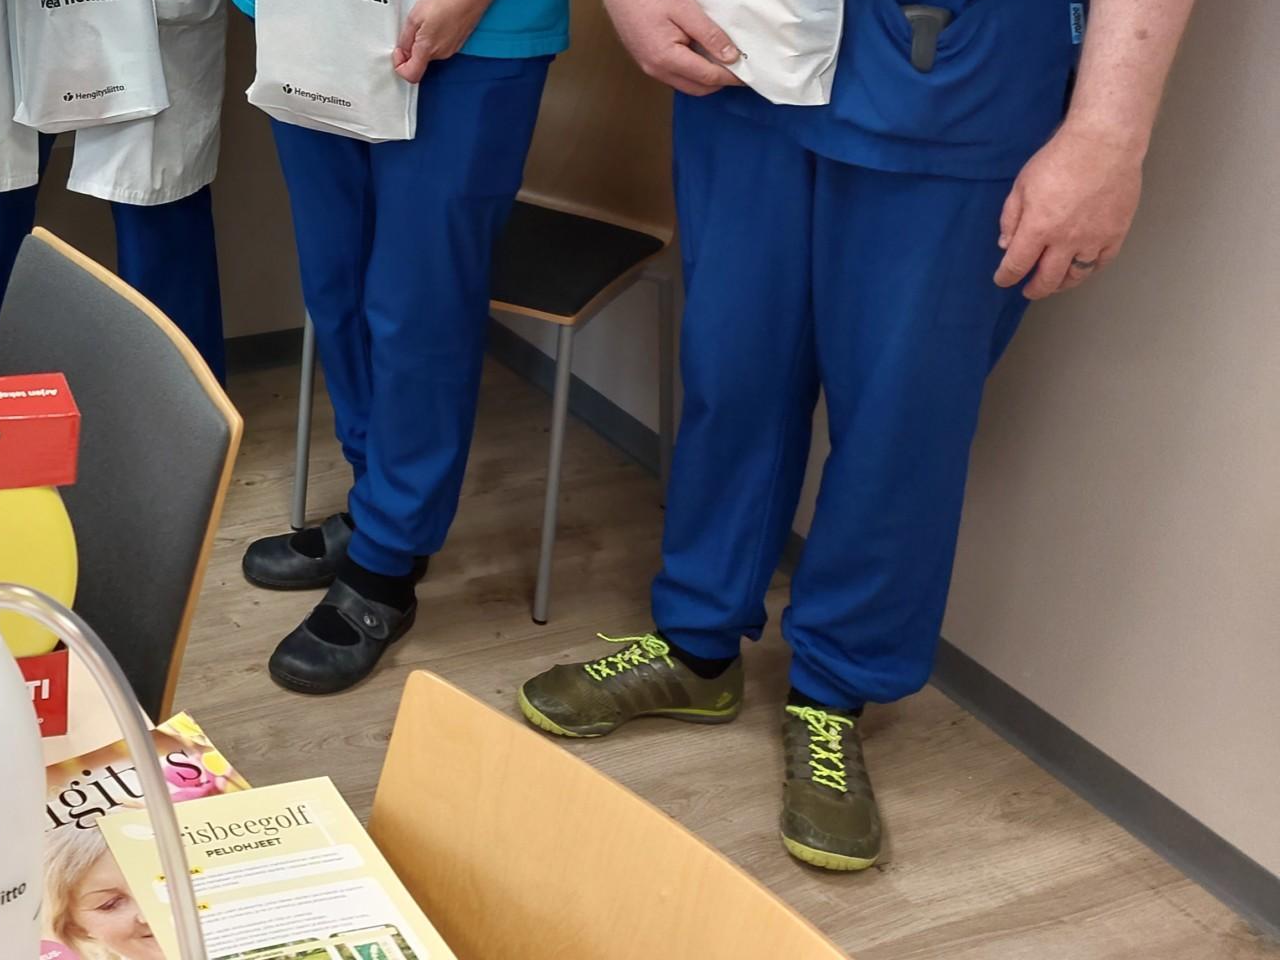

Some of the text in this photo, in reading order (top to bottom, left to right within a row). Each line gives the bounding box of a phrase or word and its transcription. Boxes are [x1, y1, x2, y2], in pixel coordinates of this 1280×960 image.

[294, 87, 352, 107] Hengitysliitto
[181, 804, 313, 846] isbeegolf
[205, 837, 283, 858] PELIOHJEET
